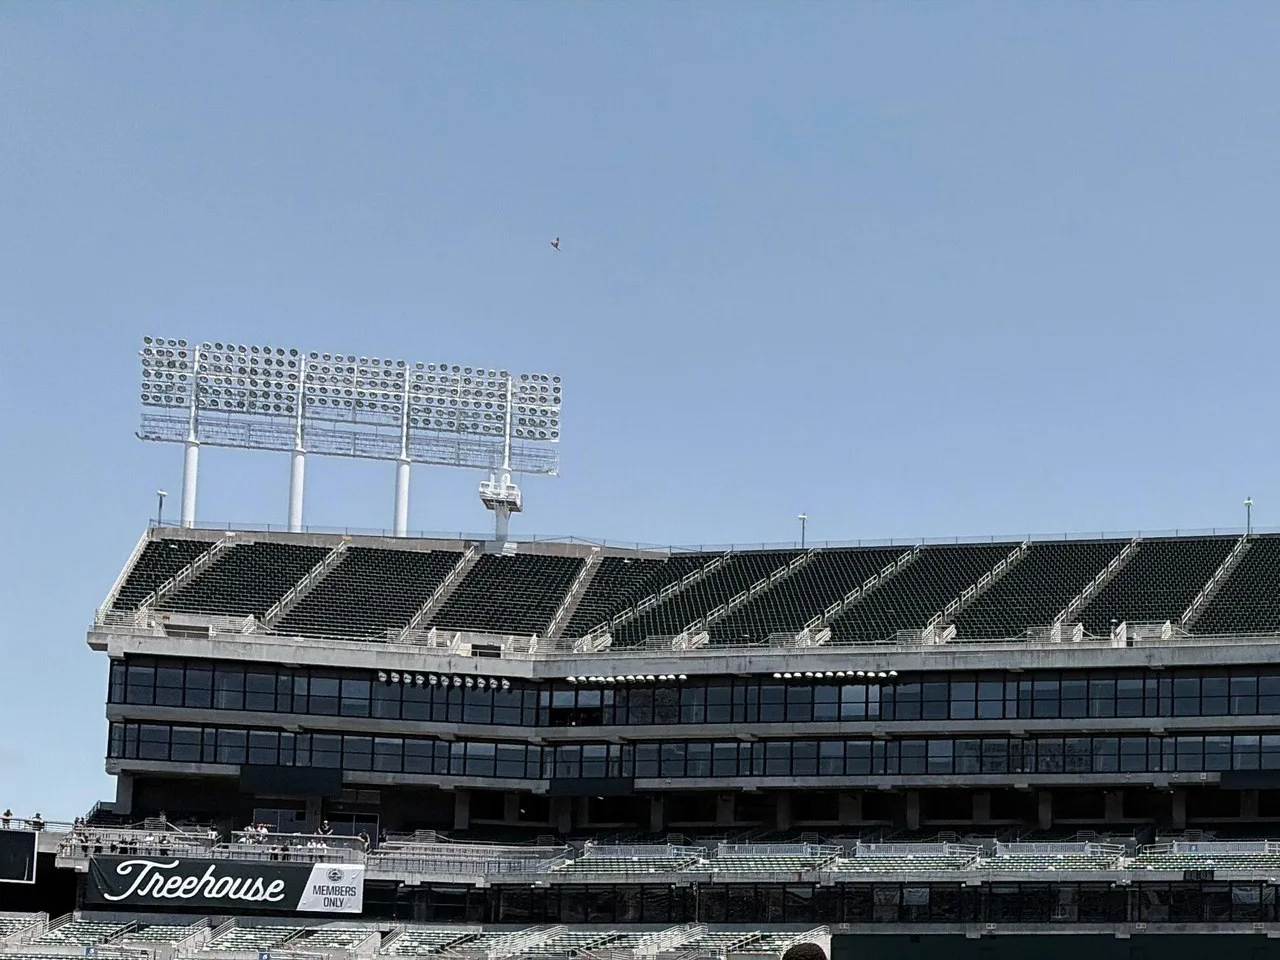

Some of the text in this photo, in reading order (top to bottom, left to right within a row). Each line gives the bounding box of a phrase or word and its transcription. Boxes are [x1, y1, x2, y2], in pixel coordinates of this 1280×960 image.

[103, 859, 286, 902] Treehouse
[312, 884, 357, 897] MEMBERS
[323, 896, 345, 908] ONLY
